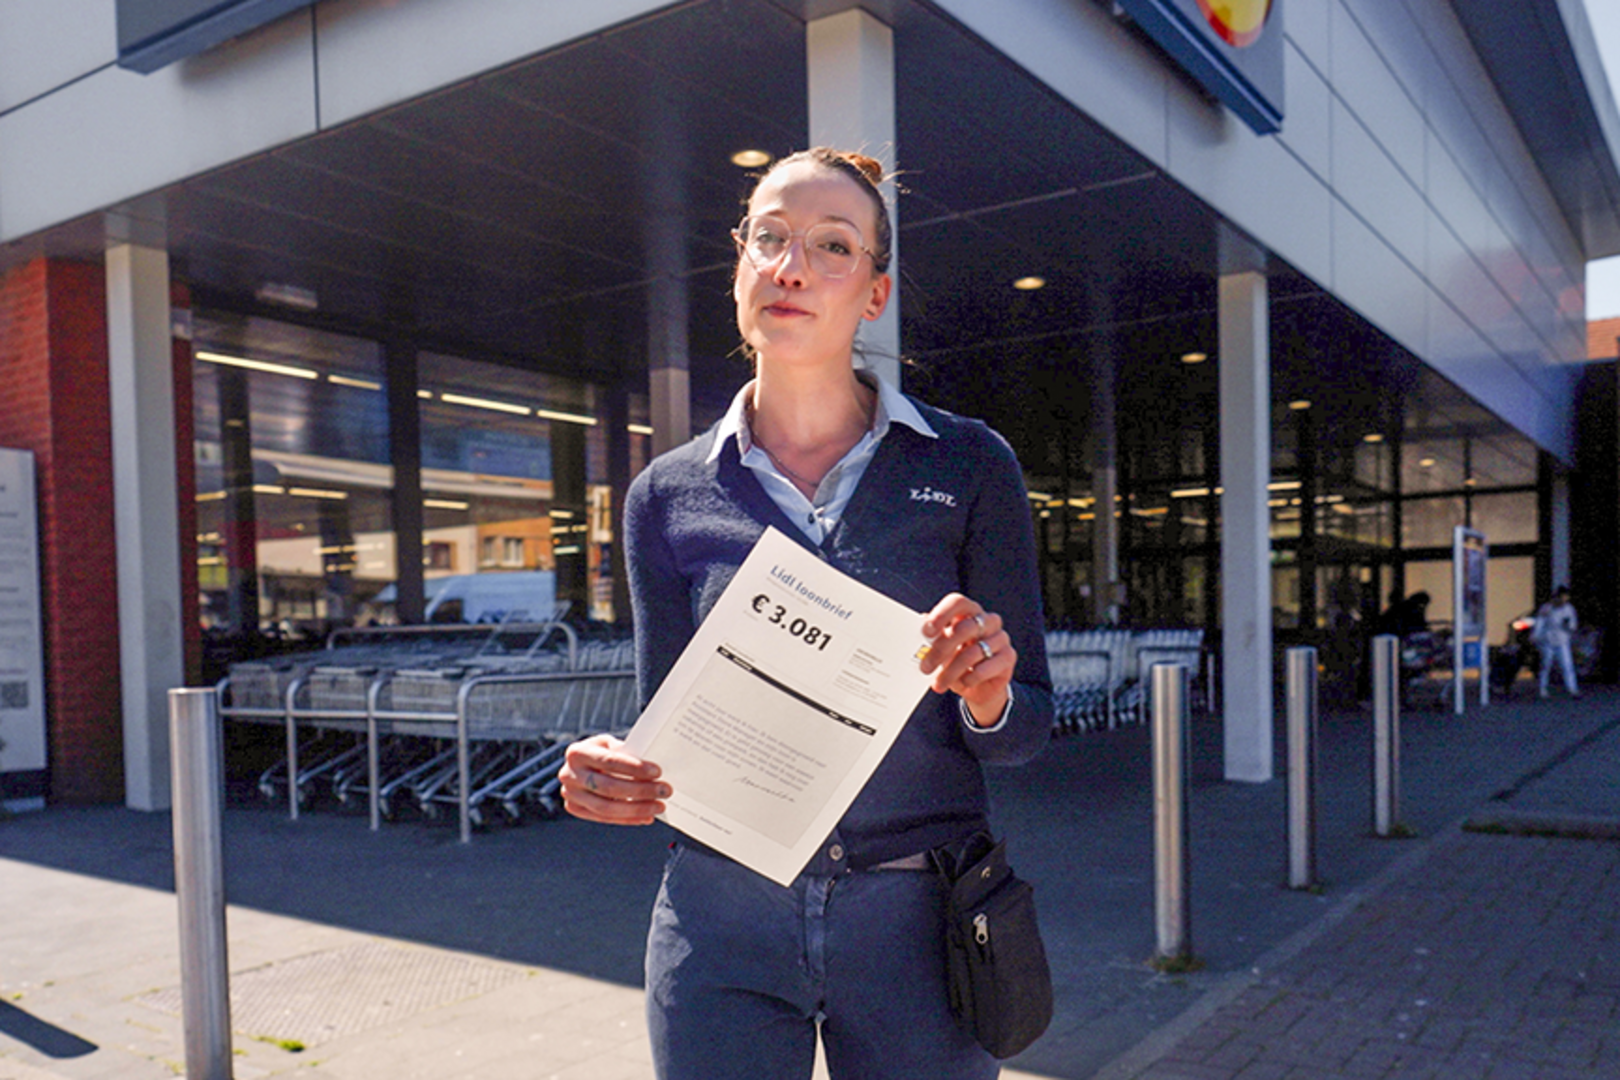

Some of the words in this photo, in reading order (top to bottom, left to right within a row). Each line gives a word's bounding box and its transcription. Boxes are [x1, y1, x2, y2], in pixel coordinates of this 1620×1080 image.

[771, 565, 796, 587] Lidl
[795, 581, 853, 619] loonbrief
[752, 594, 770, 614] €
[768, 605, 832, 651] 3.081
